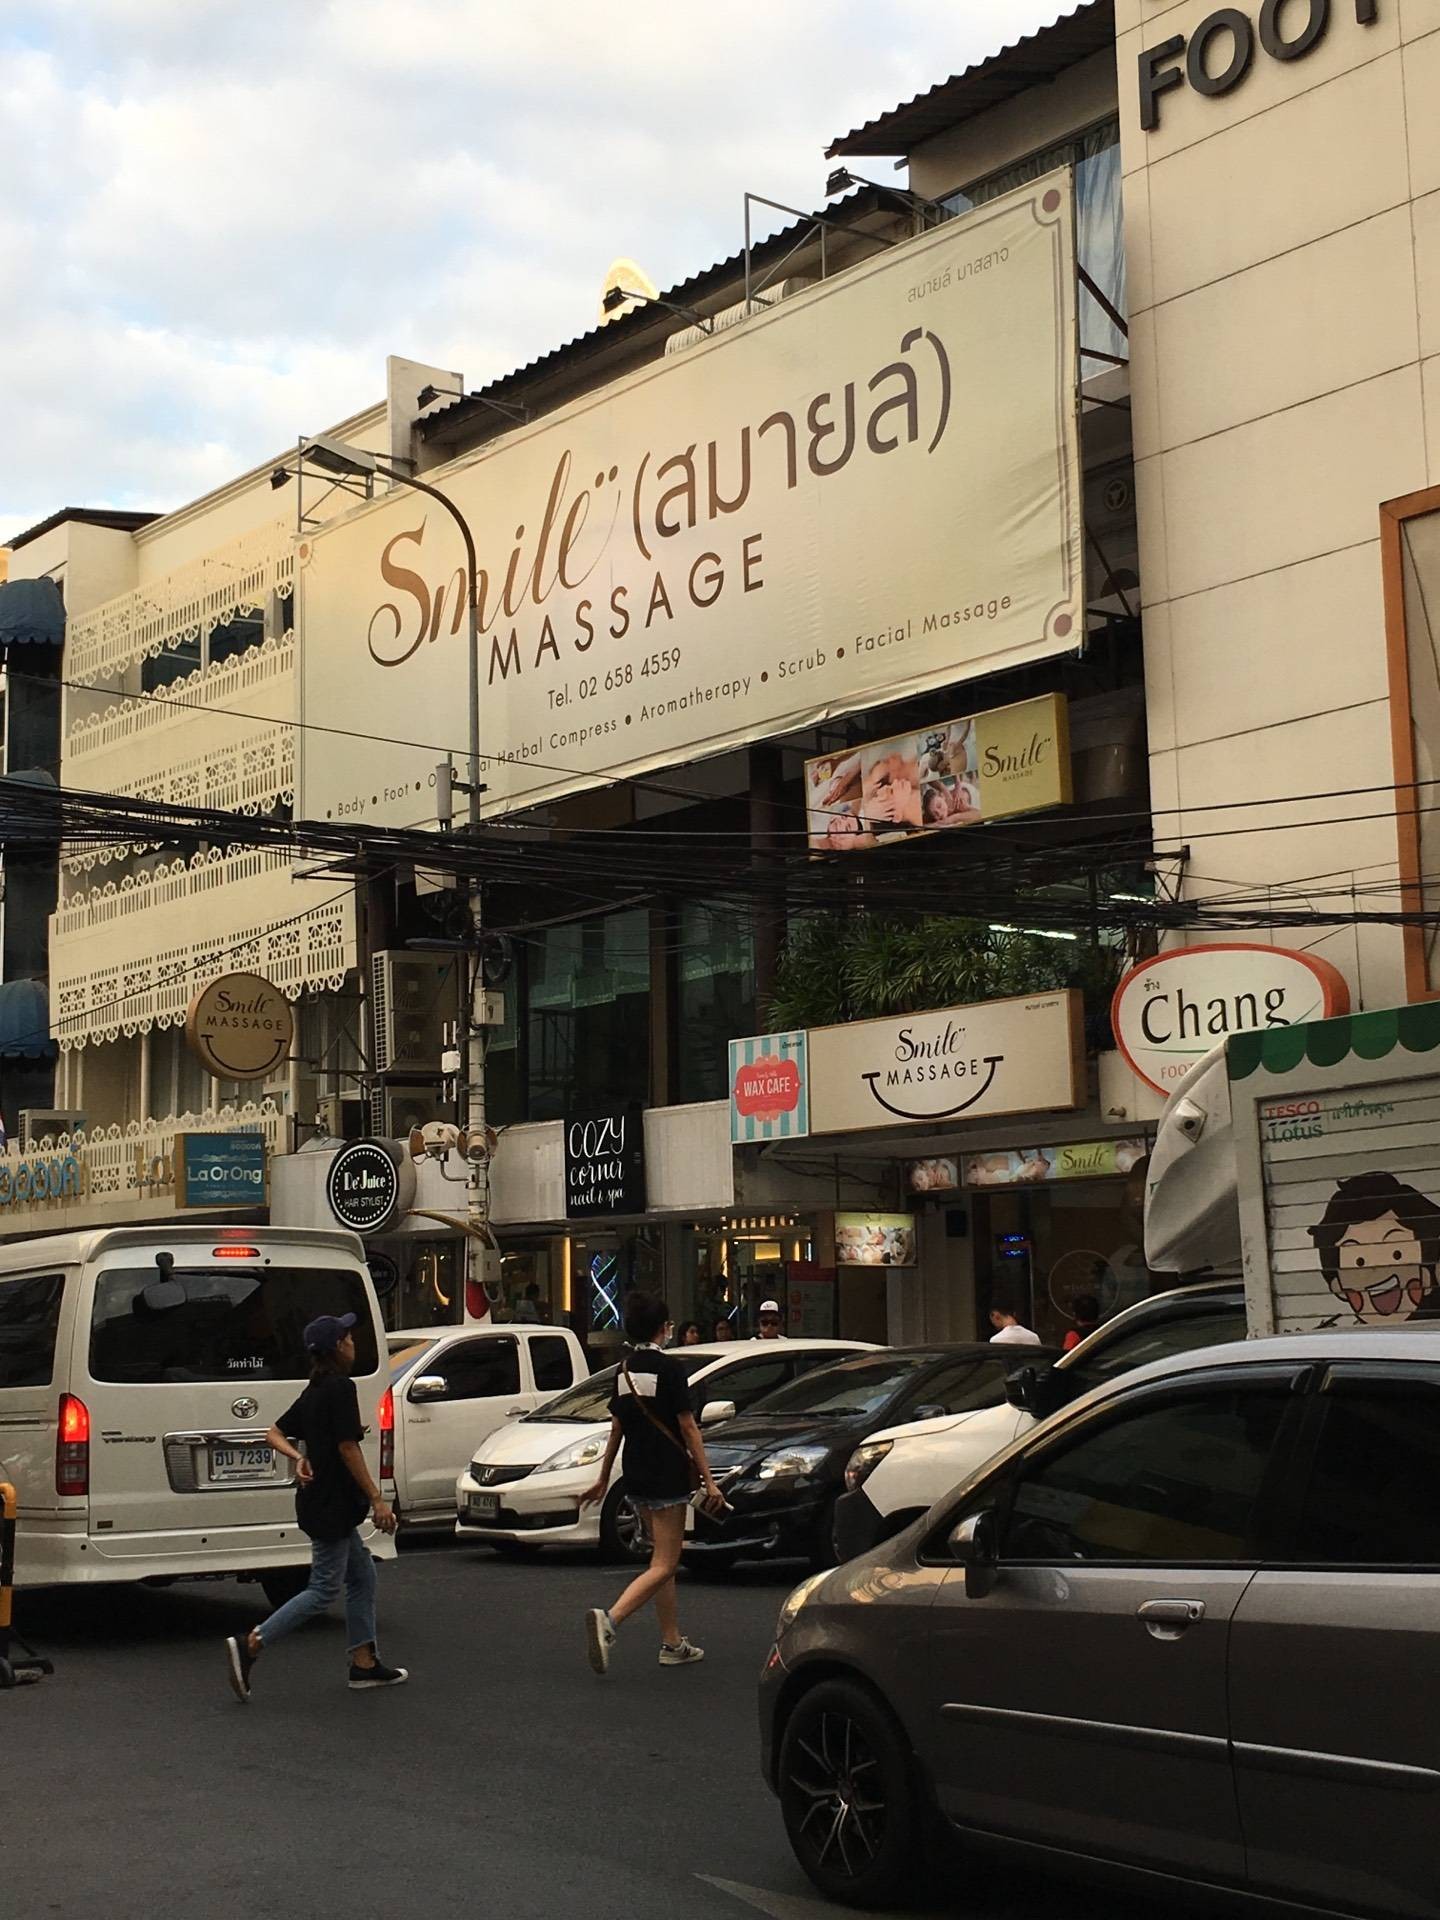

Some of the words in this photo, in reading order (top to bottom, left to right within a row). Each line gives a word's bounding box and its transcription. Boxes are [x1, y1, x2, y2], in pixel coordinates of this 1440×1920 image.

[1138, 0, 1378, 131] FOO
[368, 449, 621, 667] Smile
[488, 533, 764, 685] MASSAGE
[547, 683, 573, 709] Tel.
[579, 676, 598, 699] 02
[604, 664, 633, 691] 658
[641, 647, 681, 678] 4559
[337, 796, 366, 816] Body
[384, 783, 409, 802] Foot
[497, 736, 543, 767] Herbal
[550, 718, 617, 749] Compress
[640, 676, 751, 721] Aromatherapy
[778, 649, 826, 679] Scrub
[856, 619, 911, 654] Facial
[922, 594, 1012, 634] Massage
[982, 733, 1050, 778] Smile
[215, 991, 273, 1014] Smile
[1141, 988, 1290, 1044] Chang
[206, 1016, 283, 1031] MASSAGE
[895, 1021, 966, 1062] Smile
[886, 1059, 978, 1086] MASSAGE
[743, 1080, 765, 1097] WAX
[767, 1077, 791, 1095] CAFE
[1265, 1101, 1320, 1119] TESCO
[1267, 1124, 1323, 1143] Lotus
[570, 1158, 625, 1186] corner
[344, 1197, 359, 1208] HAIR
[360, 1195, 384, 1207] STYLIST
[570, 1186, 595, 1206] nail
[606, 1187, 624, 1209] spa
[238, 1448, 272, 1466] 7239
